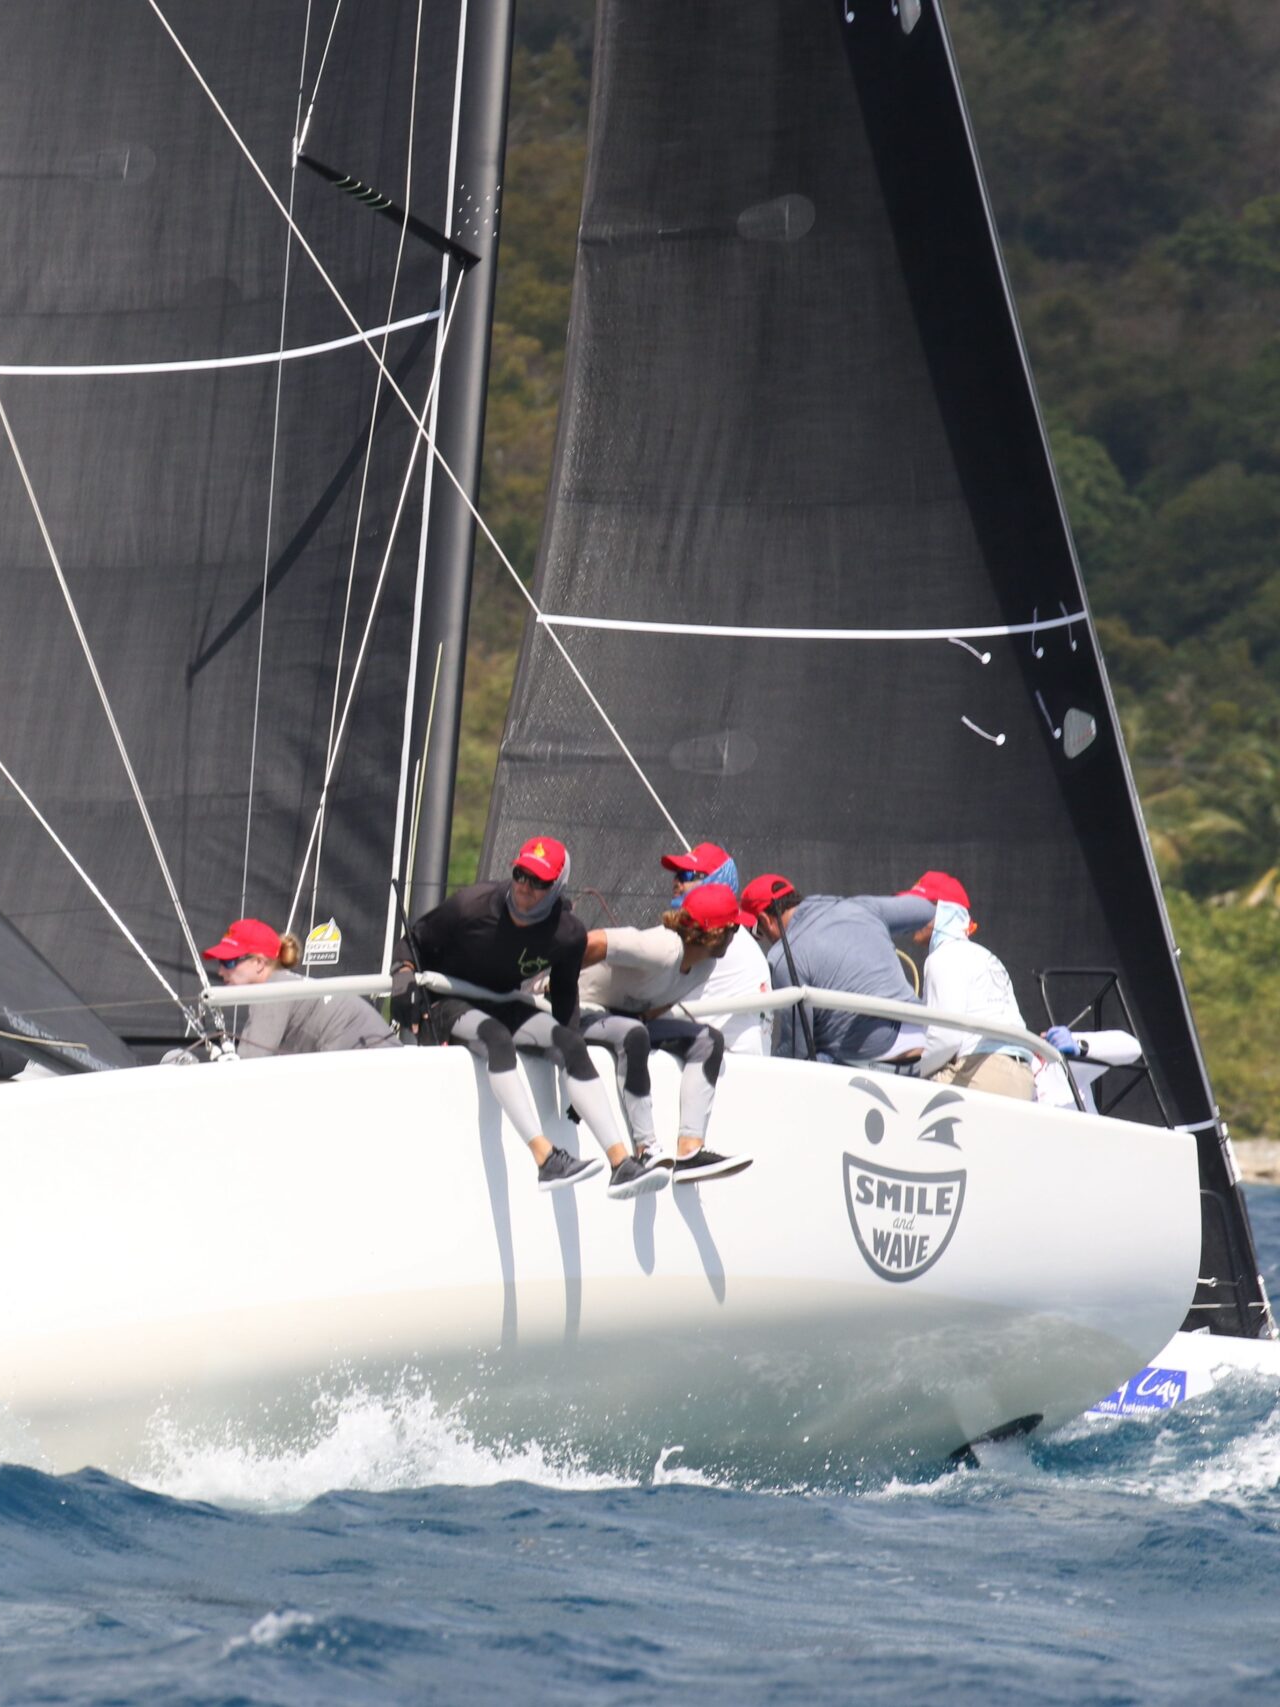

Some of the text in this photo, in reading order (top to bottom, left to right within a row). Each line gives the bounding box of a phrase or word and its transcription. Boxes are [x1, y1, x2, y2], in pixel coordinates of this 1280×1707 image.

[855, 1174, 954, 1216] SMILE
[892, 1214, 916, 1231] and
[872, 1227, 930, 1269] WAVE
[1136, 1368, 1180, 1408] Cay
